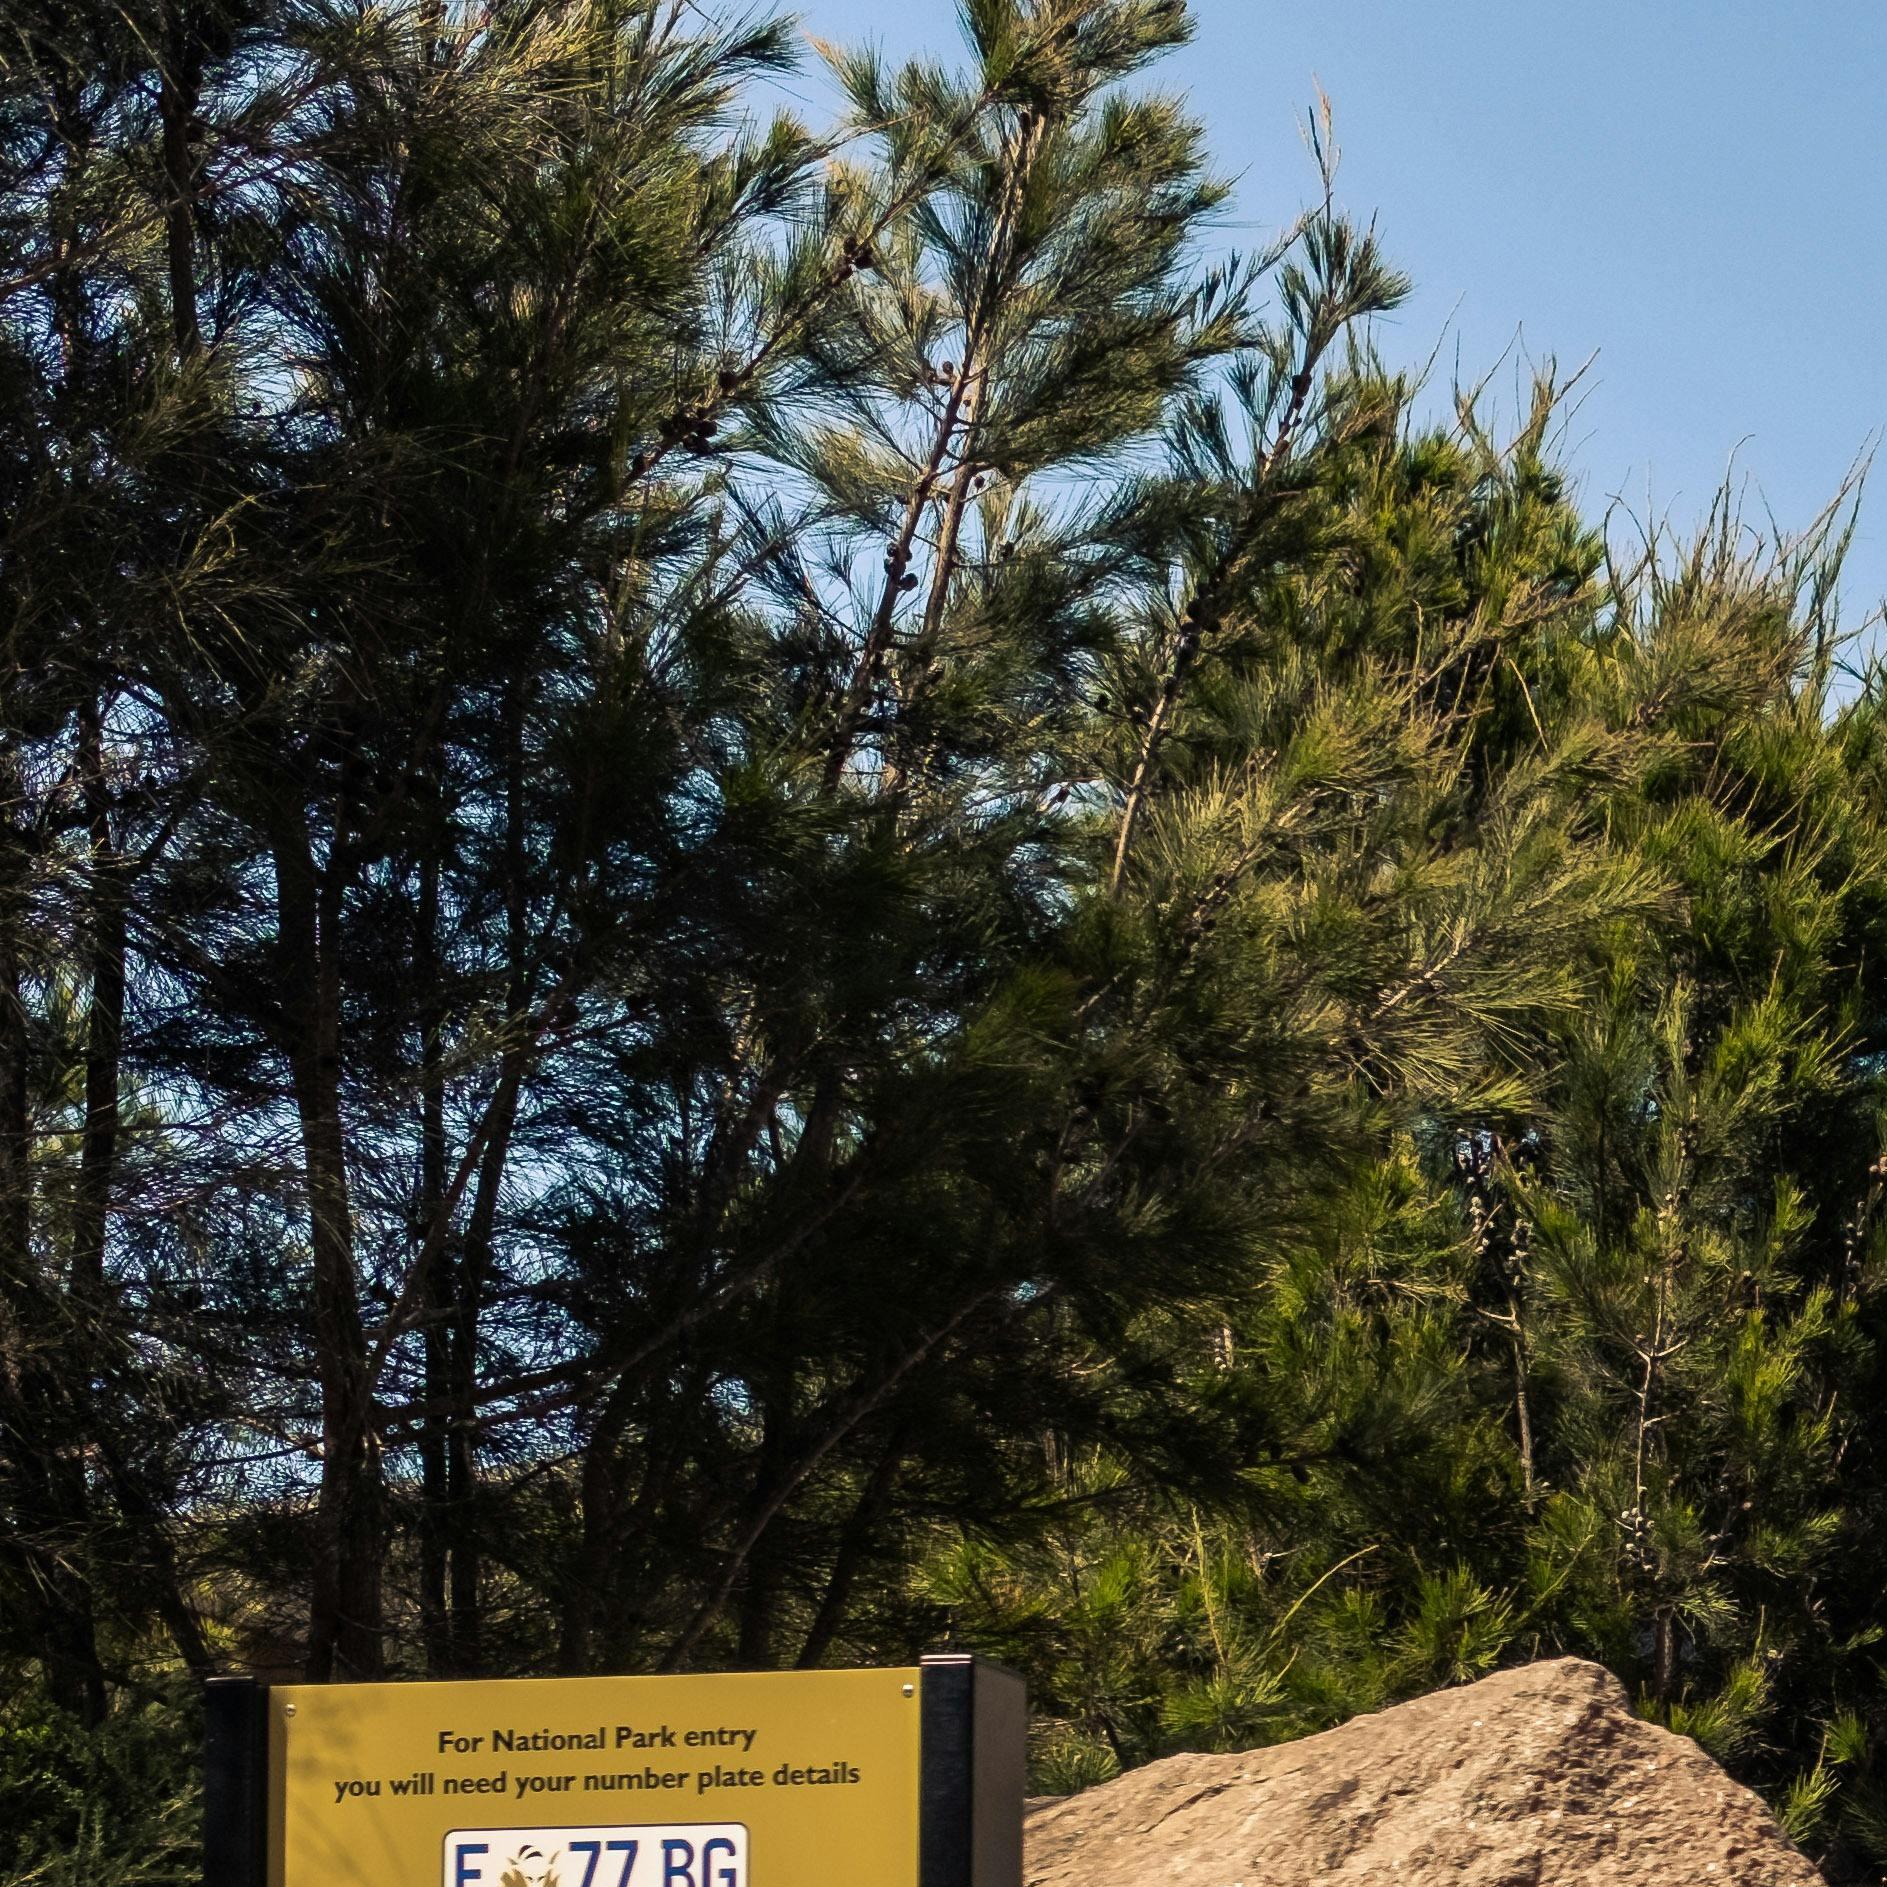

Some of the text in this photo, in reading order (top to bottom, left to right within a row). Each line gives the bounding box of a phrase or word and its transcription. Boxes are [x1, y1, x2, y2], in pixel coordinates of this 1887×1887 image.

[438, 1725, 758, 1754] For National Park entry
[335, 1761, 860, 1804] you will need your number plate details
